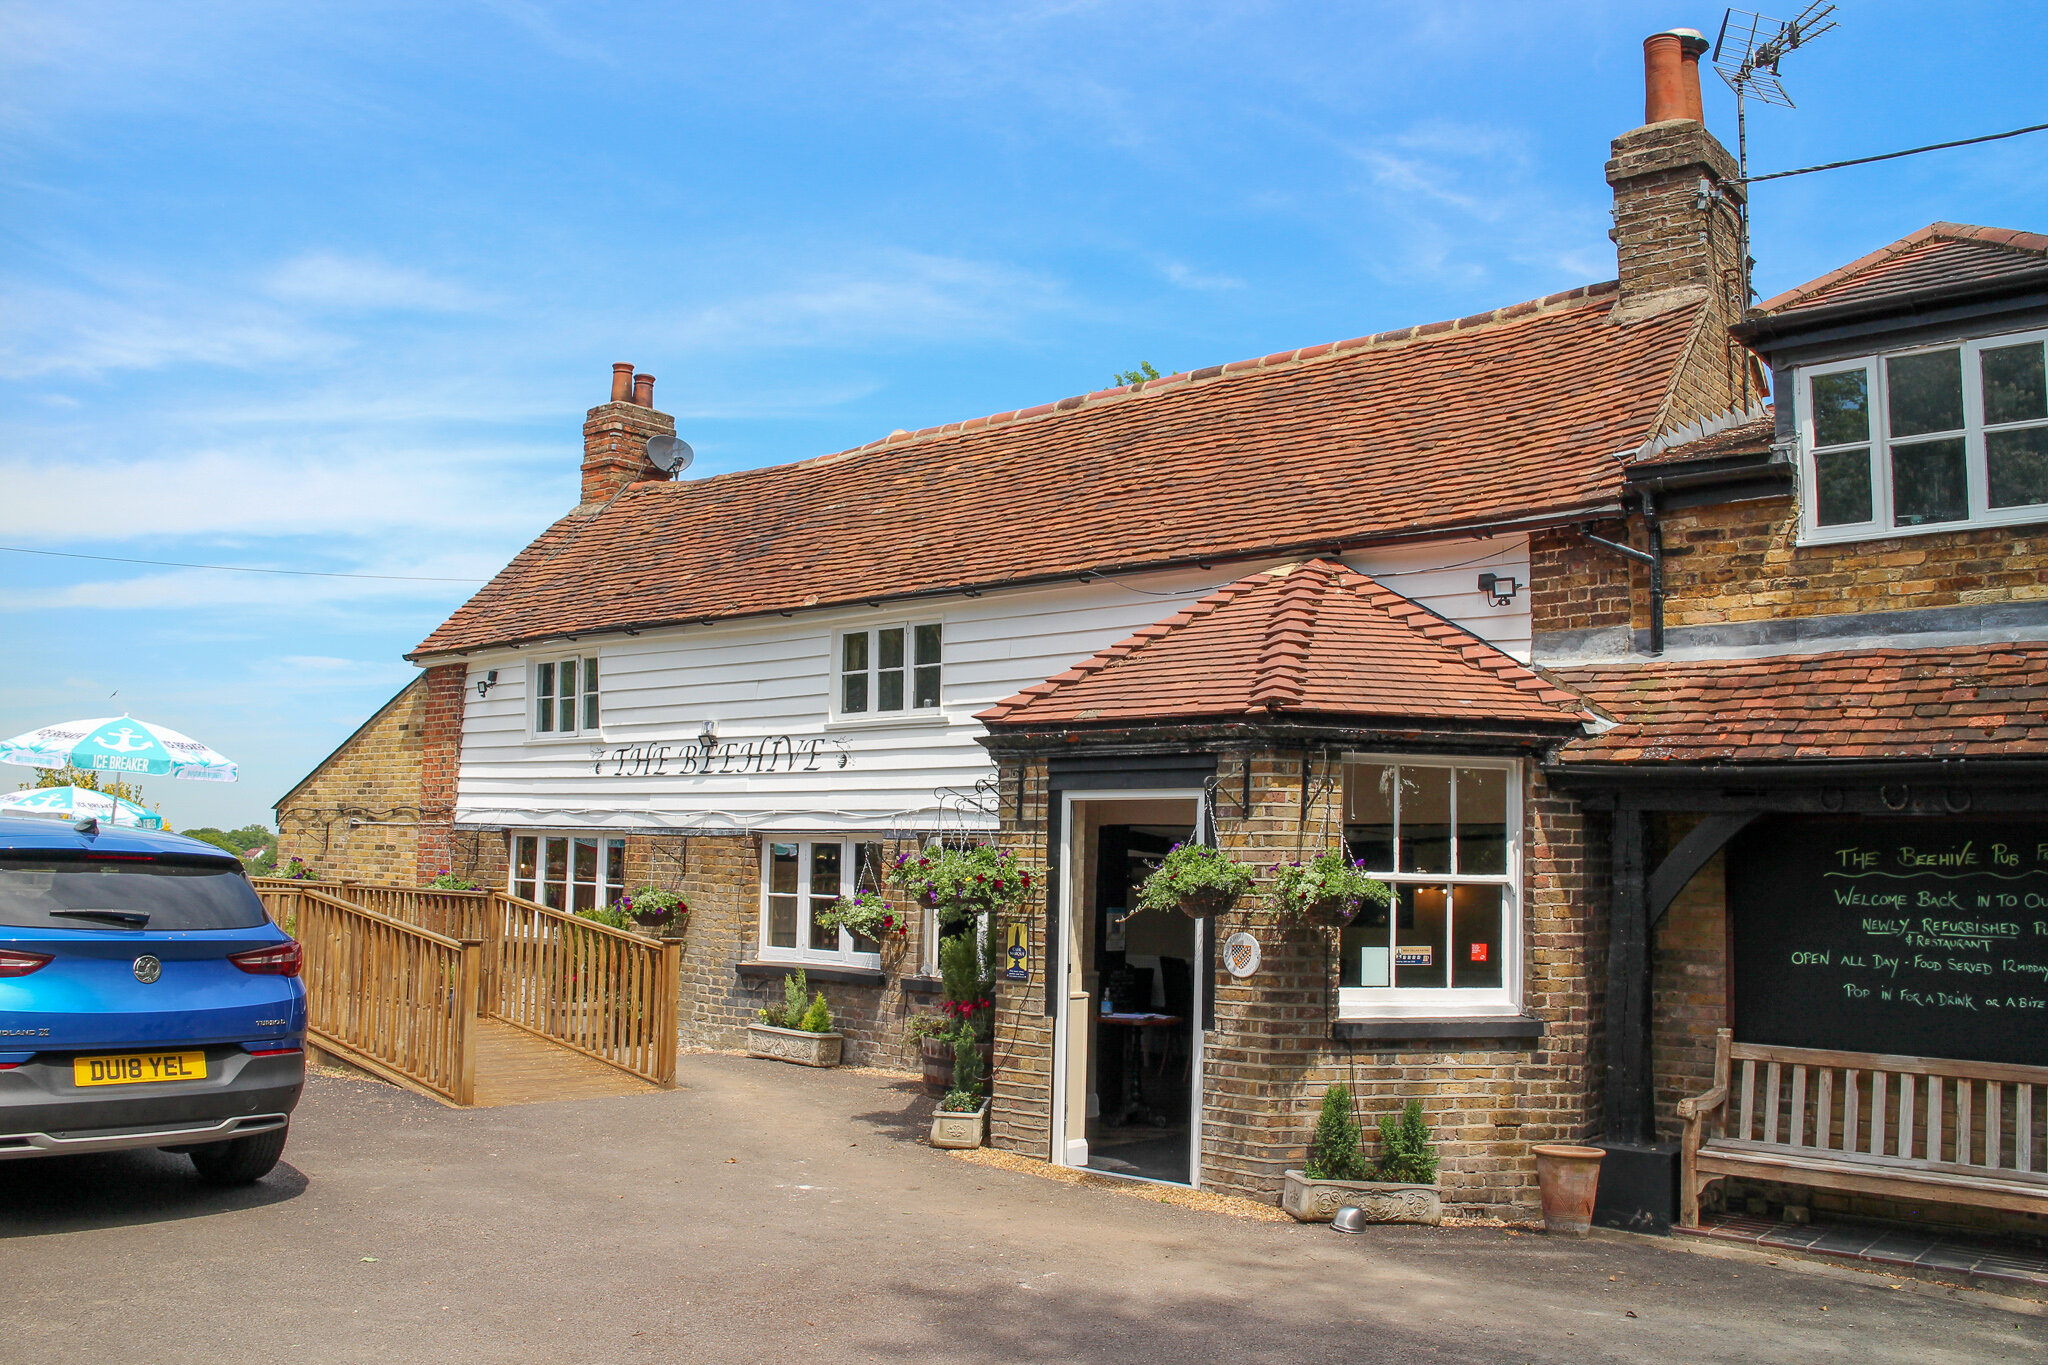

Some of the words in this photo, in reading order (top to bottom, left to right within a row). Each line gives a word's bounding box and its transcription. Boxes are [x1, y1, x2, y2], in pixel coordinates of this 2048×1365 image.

[92, 754, 108, 769] ICE
[109, 755, 149, 773] BREAKER
[611, 741, 671, 776] THE
[678, 735, 825, 775] BEEHIVE
[1835, 846, 1881, 869] THE
[1991, 843, 2020, 867] PUB
[1834, 885, 1908, 911] WELCOME
[1916, 890, 1967, 911] BACK
[1996, 893, 2018, 908] TO
[1862, 918, 1910, 937] NEWLY
[1916, 935, 1993, 953] RESTAURANT
[1791, 949, 1831, 965] OPEN
[1840, 955, 1868, 968] ALL
[1872, 954, 1899, 979] DAY
[1914, 954, 1942, 972] FOOD
[1947, 958, 1993, 975] SERVED
[1843, 983, 1871, 998] POP
[1900, 988, 1924, 1007] FOR
[1925, 993, 1934, 1004] A
[1985, 999, 2001, 1008] OR
[2005, 997, 2017, 1008] A
[255, 1019, 280, 1027] TURBO
[90, 1057, 143, 1081] DU18
[148, 1055, 193, 1077] YEL
